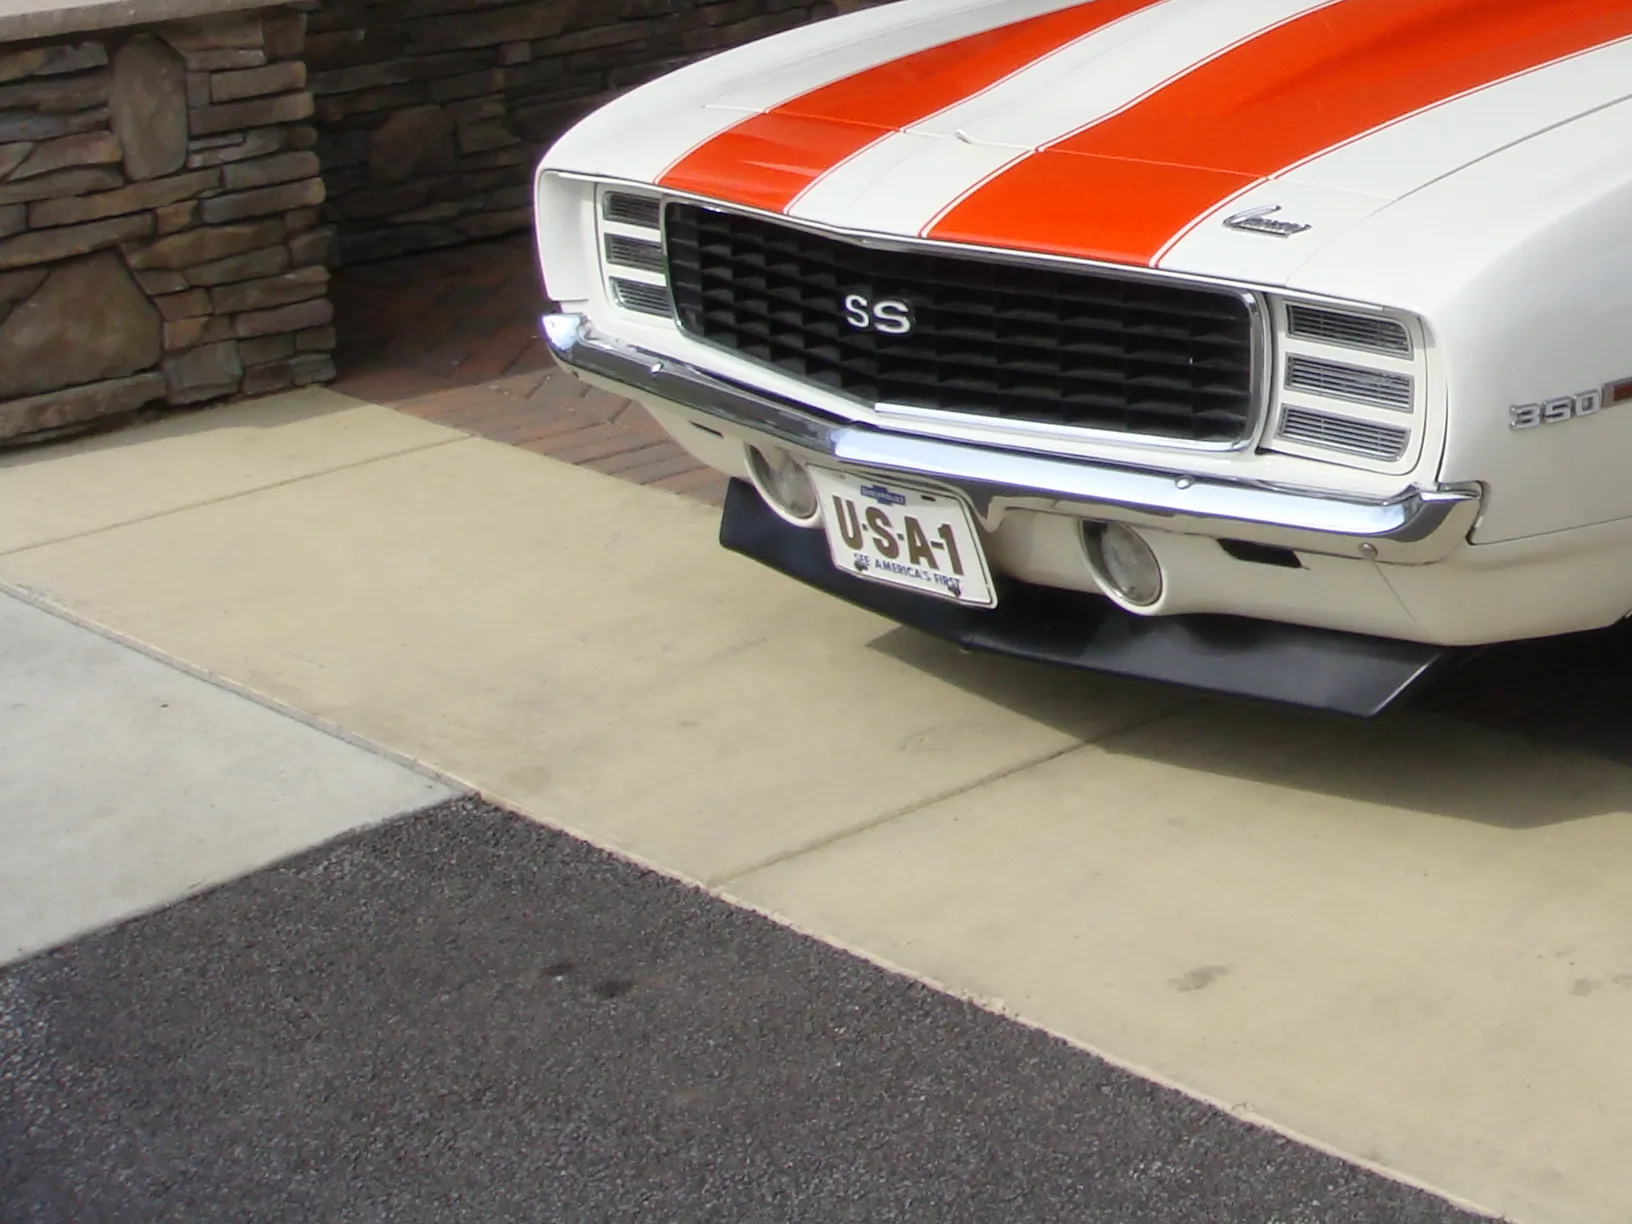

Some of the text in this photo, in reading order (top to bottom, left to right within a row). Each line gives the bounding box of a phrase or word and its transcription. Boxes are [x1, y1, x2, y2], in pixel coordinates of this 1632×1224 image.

[845, 294, 911, 334] SS
[1508, 388, 1601, 431] 350
[875, 559, 932, 582] AMERICA'S
